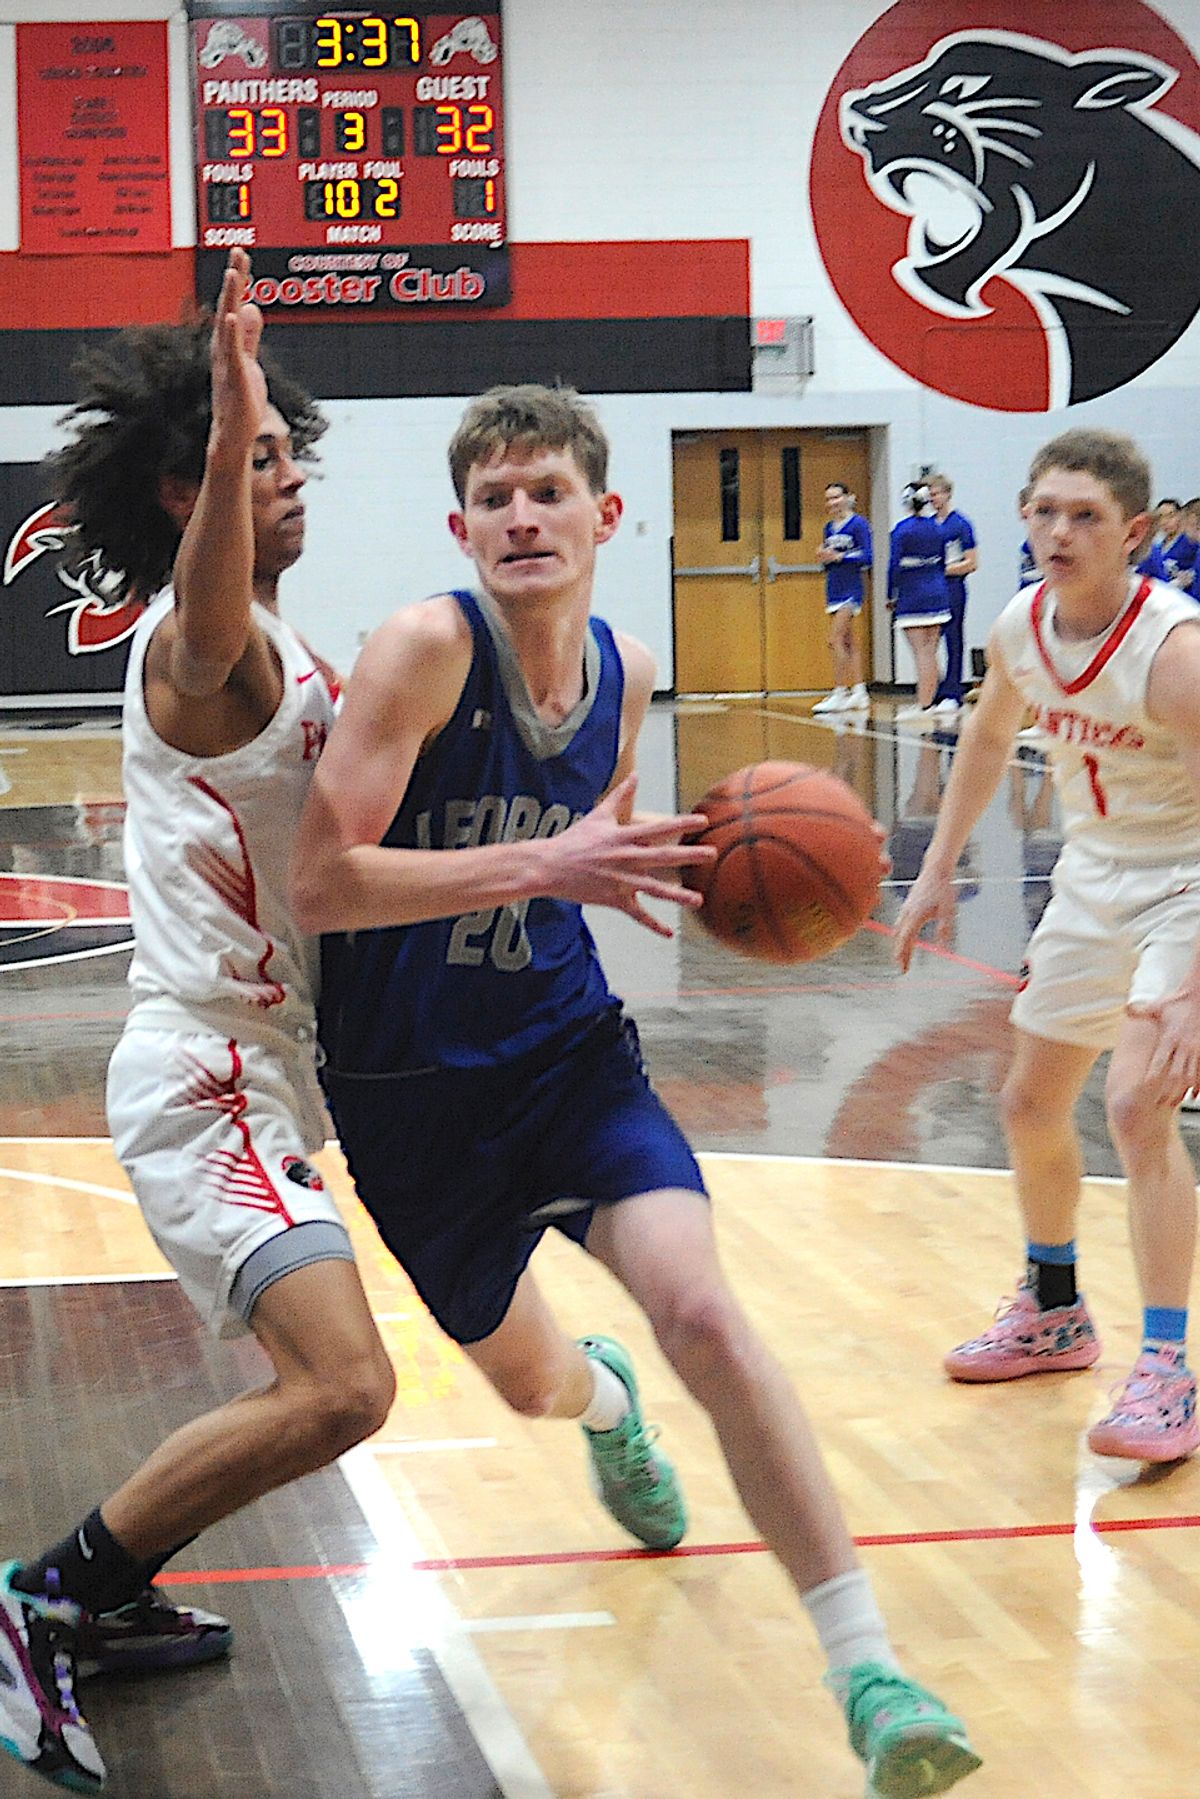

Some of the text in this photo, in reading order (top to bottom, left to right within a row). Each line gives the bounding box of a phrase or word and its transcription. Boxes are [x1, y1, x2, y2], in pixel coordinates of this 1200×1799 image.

[316, 18, 420, 67] 3:37
[203, 78, 319, 104] PANTHERS
[321, 90, 378, 108] PERIOD
[416, 76, 491, 101] GUEST
[228, 108, 289, 158] 33
[343, 112, 365, 151] 3
[435, 105, 493, 154] 32
[202, 163, 254, 182] FOULS
[298, 161, 404, 180] PLAYER FOUL
[449, 159, 500, 178] FOULS
[239, 184, 250, 218] 1
[324, 178, 399, 218] 10 2
[485, 179, 496, 213] 1
[204, 227, 256, 247] SCORE
[326, 225, 382, 244] MATCH
[450, 222, 502, 242] SCORE
[243, 267, 486, 305] ooster Club
[446, 900, 532, 971] 20
